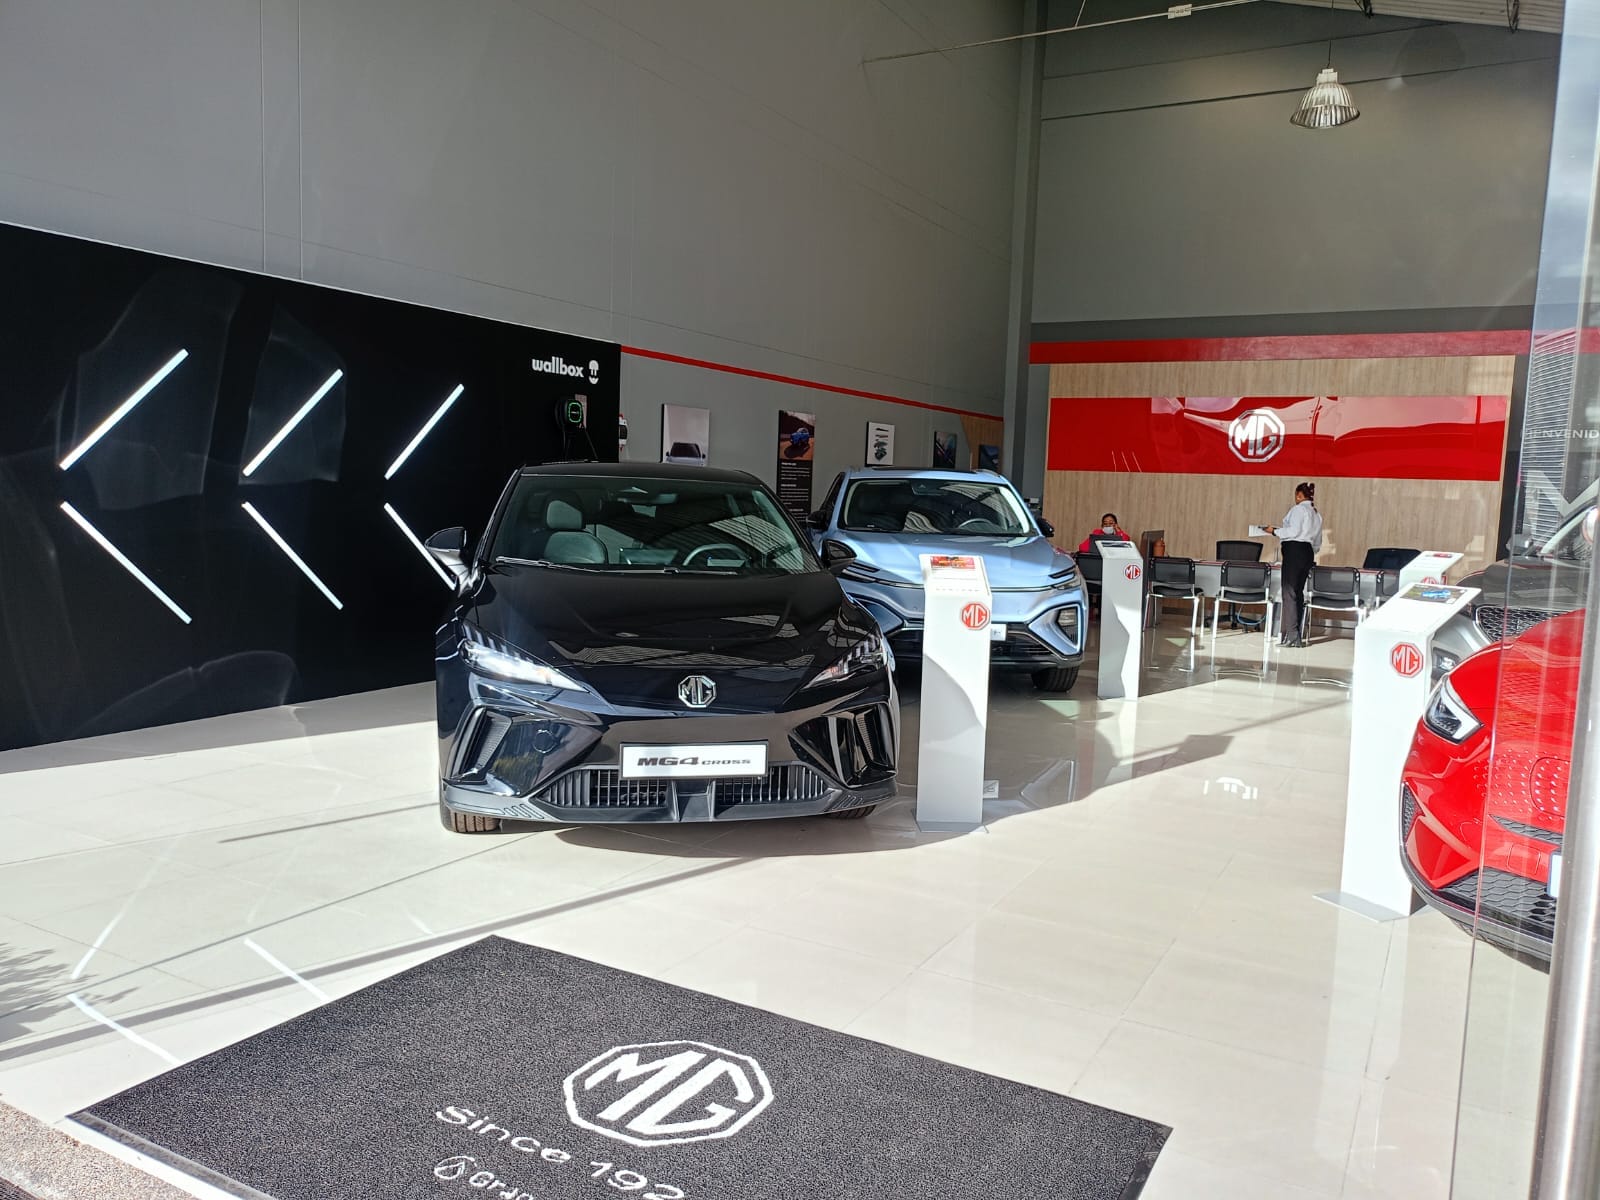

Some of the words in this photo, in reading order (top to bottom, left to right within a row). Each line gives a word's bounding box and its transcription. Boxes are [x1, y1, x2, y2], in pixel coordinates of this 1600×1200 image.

[531, 356, 584, 378] wallbox
[1233, 414, 1280, 457] MG
[1124, 564, 1141, 580] MG
[962, 604, 989, 628] MG
[1392, 645, 1420, 674] MG
[681, 677, 713, 705] MG
[637, 757, 699, 766] MG4
[584, 1050, 755, 1135] MG
[436, 1106, 571, 1163] Since
